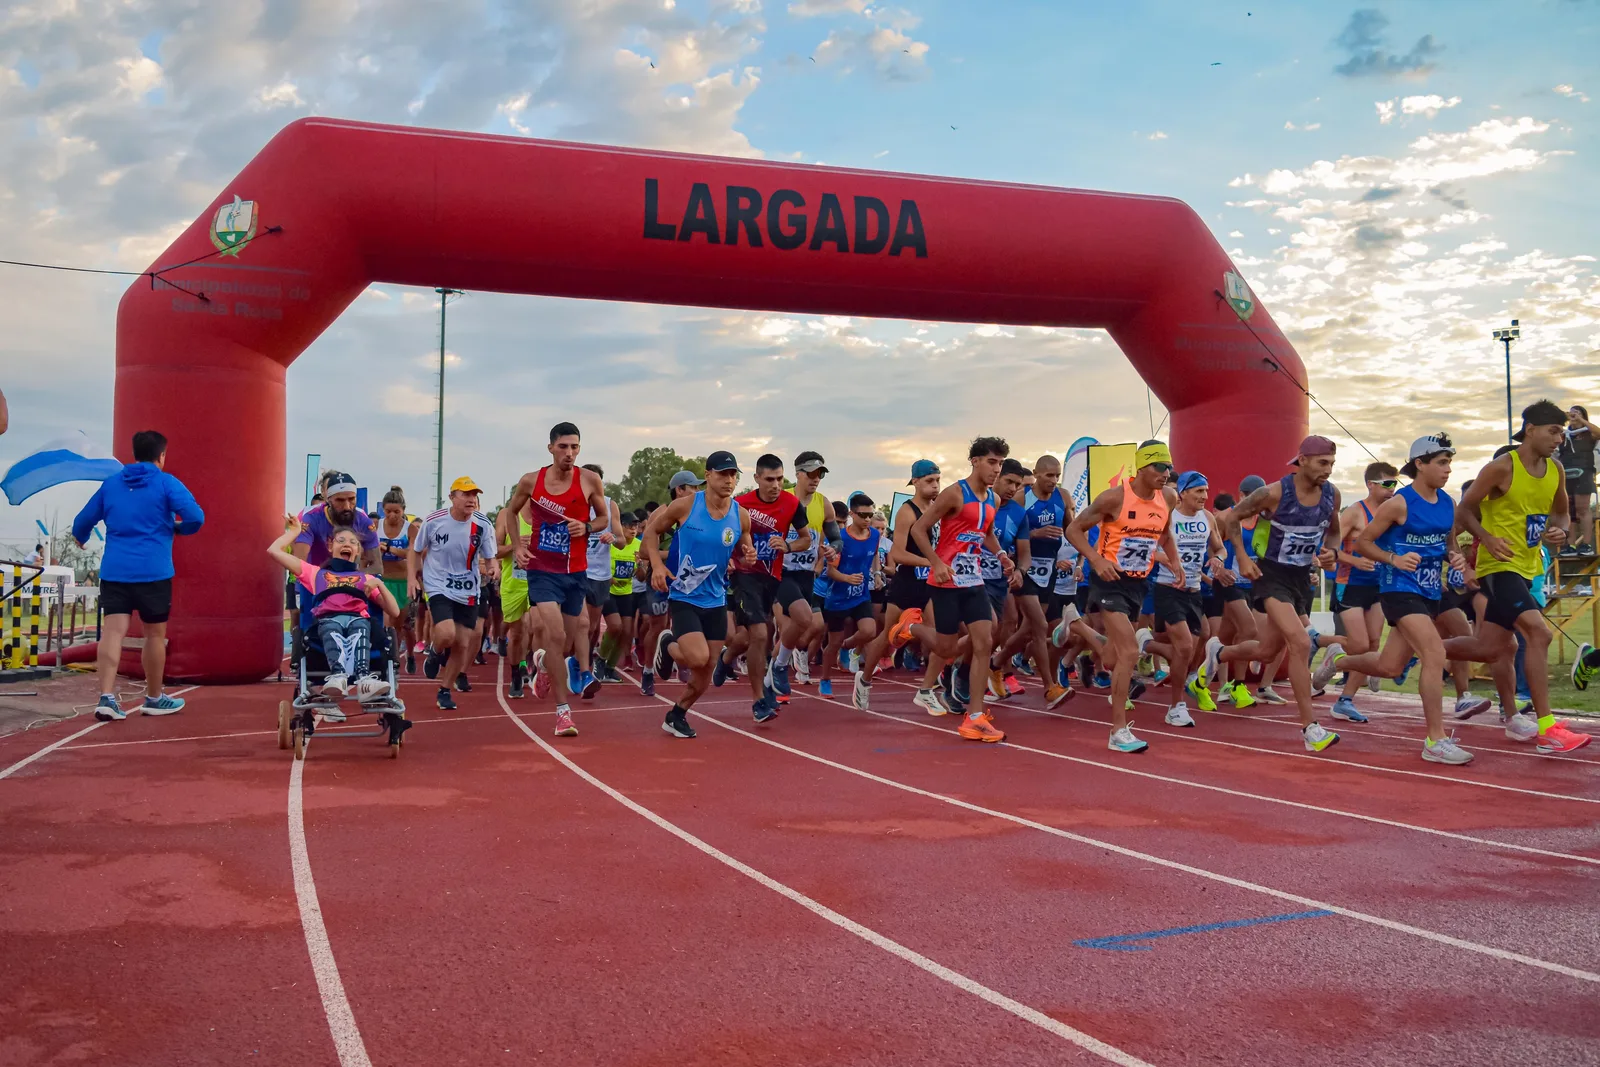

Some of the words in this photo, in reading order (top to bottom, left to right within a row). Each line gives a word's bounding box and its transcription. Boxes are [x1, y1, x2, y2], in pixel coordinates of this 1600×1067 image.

[643, 178, 928, 258] LARGADA
[538, 495, 567, 515] SPARTANS
[748, 508, 778, 528] SPARTANS
[1175, 521, 1207, 534] NEO
[540, 529, 569, 547] 1392
[1124, 548, 1149, 561] 74
[1285, 544, 1316, 555] 210
[790, 553, 816, 565] 246
[1182, 552, 1201, 563] 62
[446, 577, 474, 591] 280
